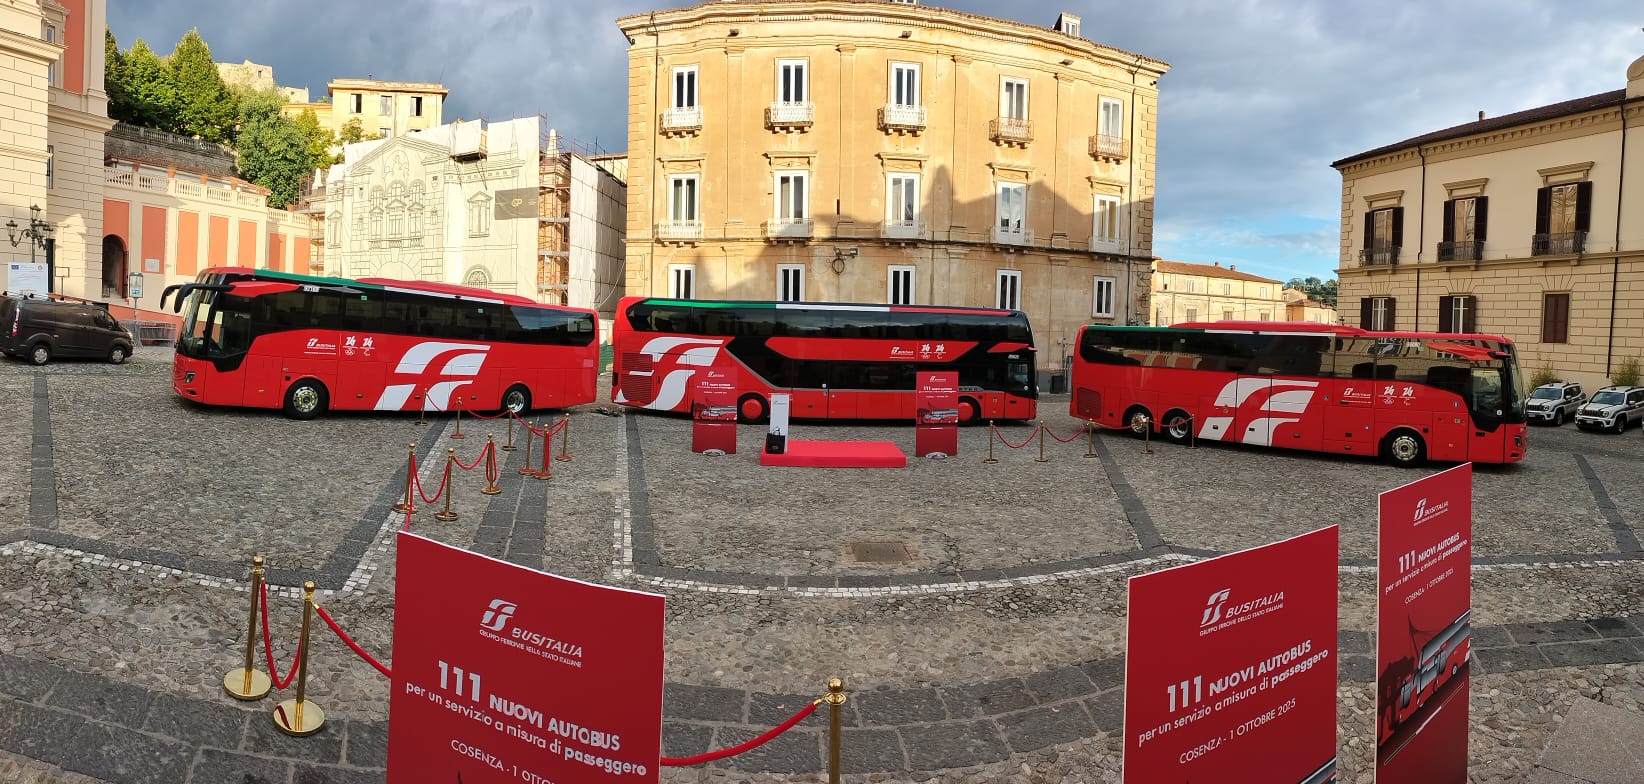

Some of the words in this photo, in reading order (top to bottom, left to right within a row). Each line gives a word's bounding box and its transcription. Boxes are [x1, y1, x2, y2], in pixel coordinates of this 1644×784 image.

[1398, 549, 1416, 574] 111
[1225, 591, 1284, 618] BUSITALIA
[511, 627, 583, 658] BUSITALIA
[1167, 674, 1202, 712] 111
[1209, 665, 1254, 697] NUOVI
[1257, 639, 1312, 676] AUTOBUS
[406, 681, 426, 697] per
[428, 691, 443, 705] un
[445, 698, 493, 726] servizio
[494, 720, 504, 731] a
[506, 724, 547, 749] misura
[549, 737, 562, 755] di
[564, 745, 648, 776] passeggero
[438, 659, 481, 703] 111
[489, 693, 543, 729] NUOVI
[547, 717, 621, 751] AUTOBUS
[1138, 727, 1157, 748] per
[1158, 721, 1171, 735] un
[1174, 704, 1212, 729] servizio
[1214, 700, 1222, 711] a
[1223, 685, 1257, 708] misura
[1259, 675, 1269, 691] di
[1271, 648, 1329, 688] passeggero
[1179, 736, 1222, 764] COSENZA
[1230, 729, 1234, 740] 1
[1236, 708, 1276, 736] OTTOBRE
[1277, 697, 1297, 717] 2025
[451, 739, 504, 772] COSENZA
[512, 764, 518, 776] 1
